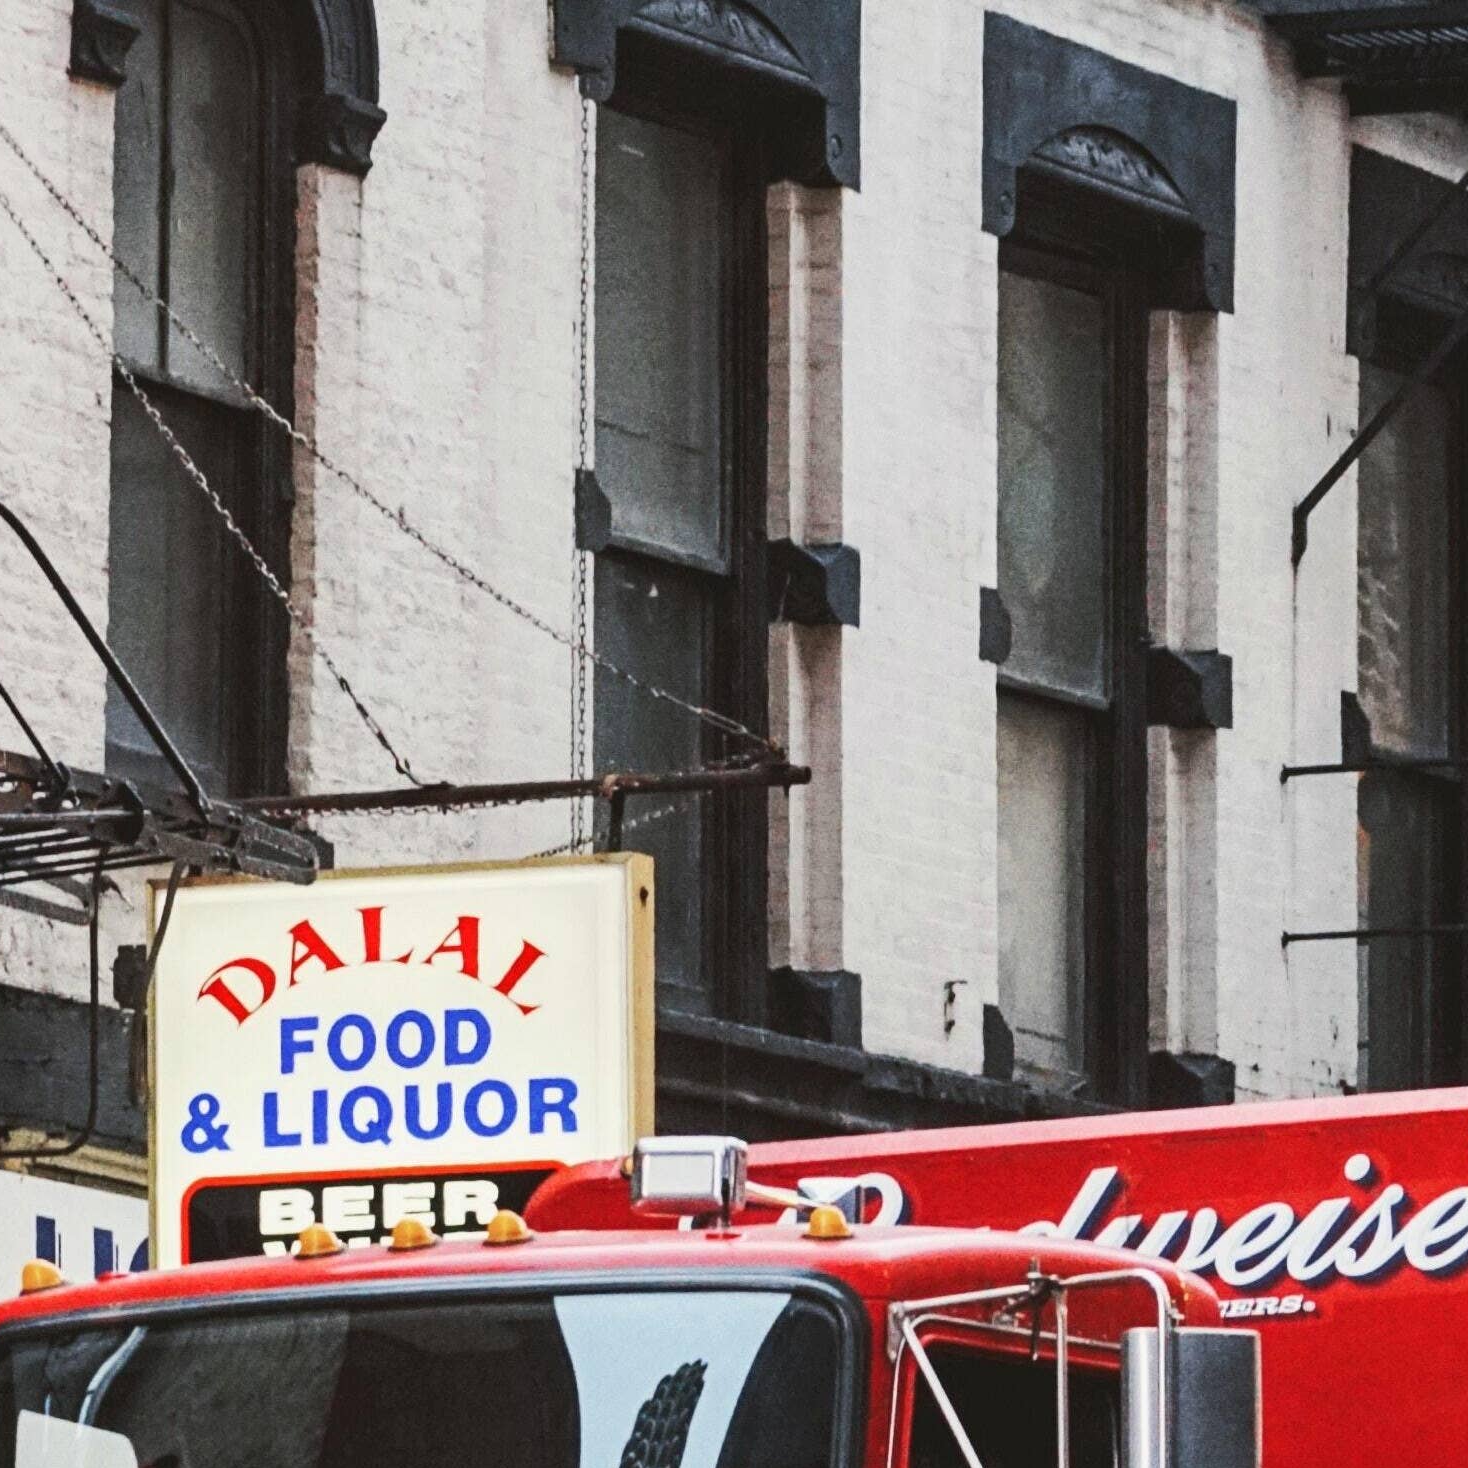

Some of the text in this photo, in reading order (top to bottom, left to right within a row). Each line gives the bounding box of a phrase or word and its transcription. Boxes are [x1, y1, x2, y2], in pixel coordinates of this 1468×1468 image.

[196, 905, 549, 1027] DALAL
[279, 1008, 492, 1075] FOOD
[180, 1077, 579, 1155] & LIQUOR
[258, 1180, 500, 1237] BEER
